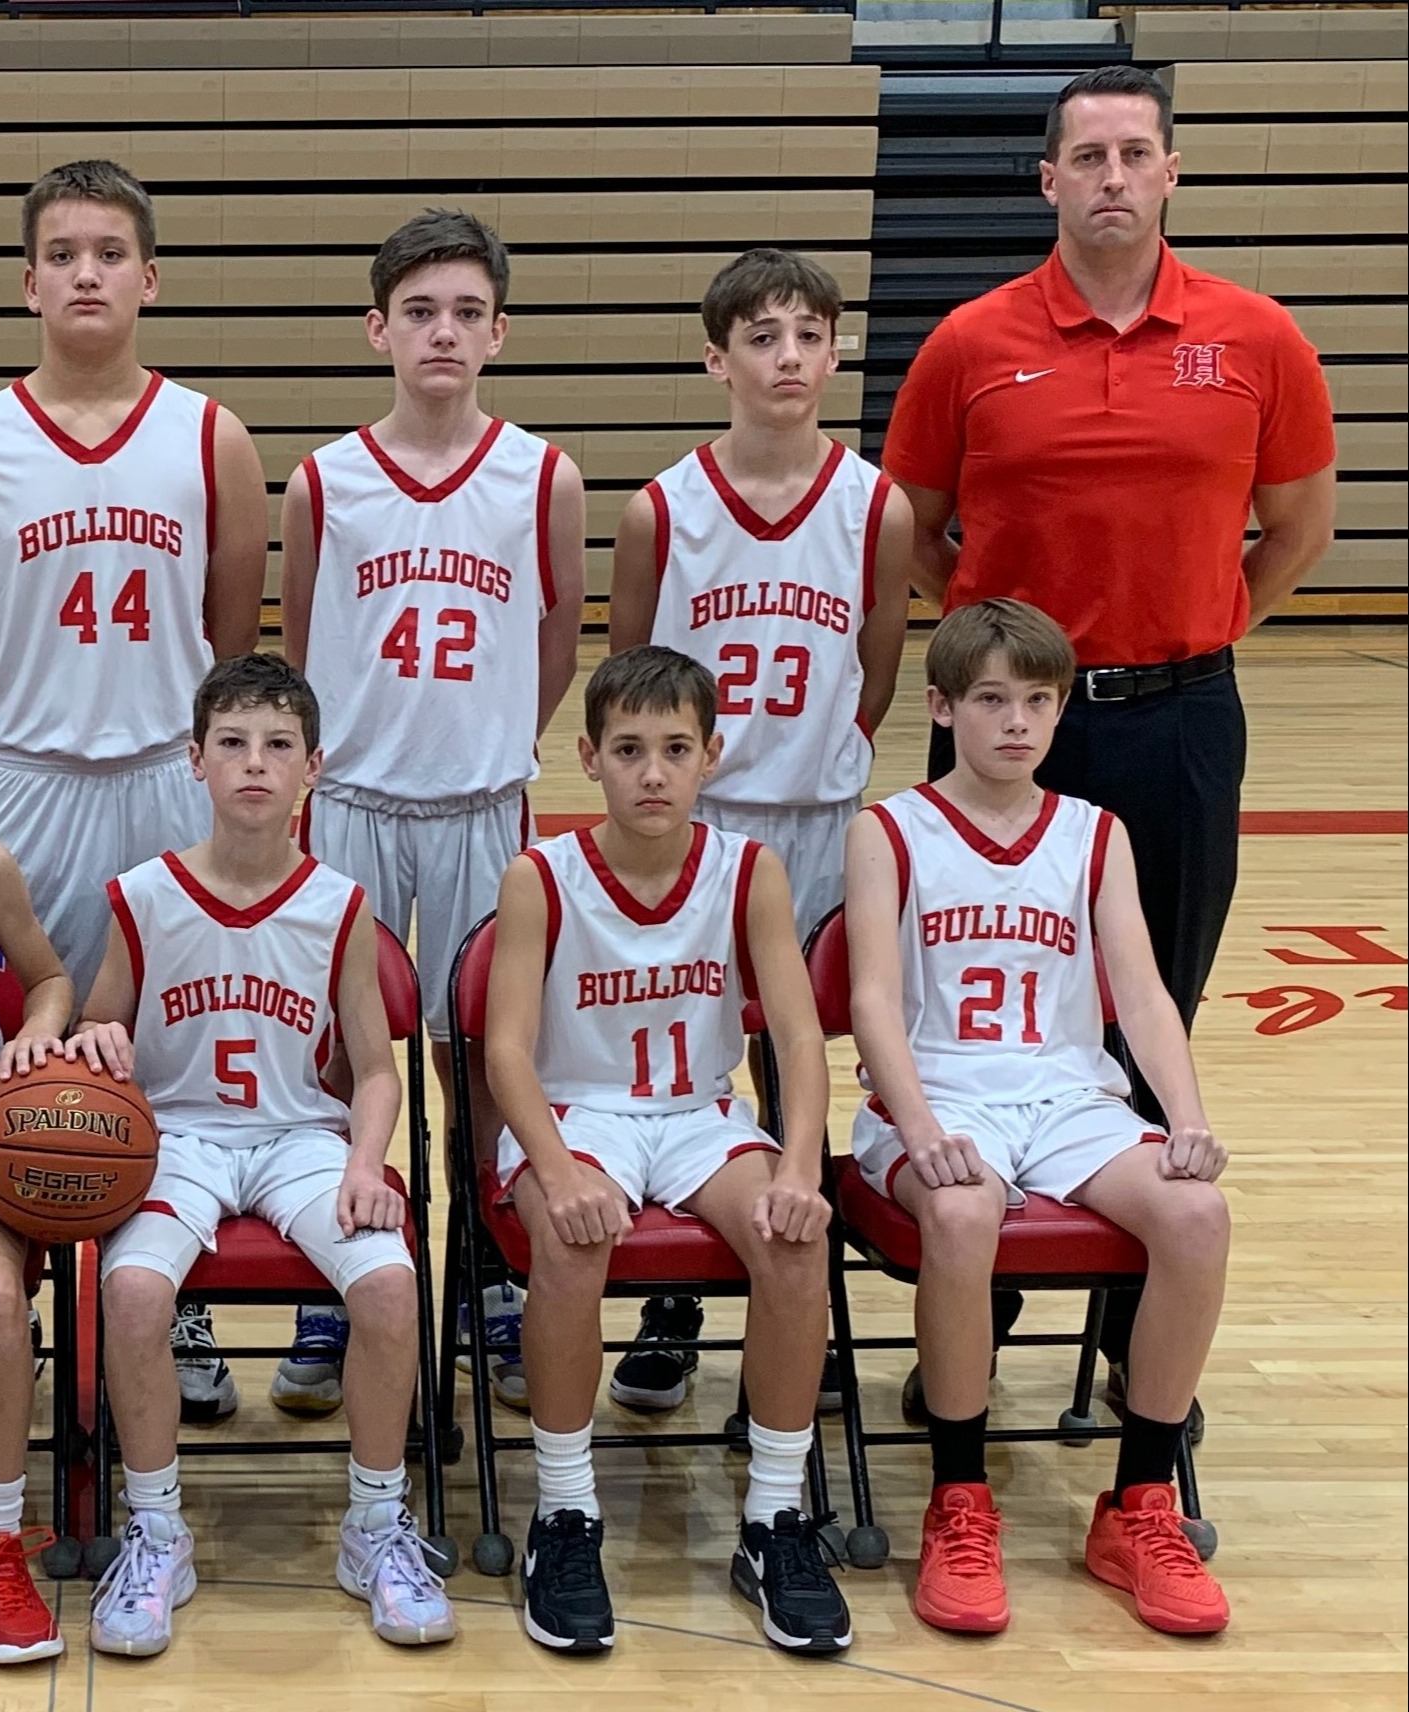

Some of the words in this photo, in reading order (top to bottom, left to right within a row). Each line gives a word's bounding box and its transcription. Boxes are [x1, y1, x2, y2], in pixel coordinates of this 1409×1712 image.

[1172, 343, 1226, 387] H
[19, 506, 181, 562] BULLDOGS
[357, 549, 511, 602] BULLDOGS
[59, 569, 150, 644] 44
[690, 582, 849, 634] BULLDOGS
[381, 607, 477, 682] 42
[716, 643, 811, 717] 23
[160, 974, 316, 1035] BULLDOGS
[577, 959, 727, 1010] BULLDOG
[958, 967, 1042, 1043] 21
[215, 1039, 258, 1109] 5
[631, 1021, 693, 1097] 11
[3, 1107, 131, 1147] SPALDING
[8, 1162, 118, 1192] LEGACY
